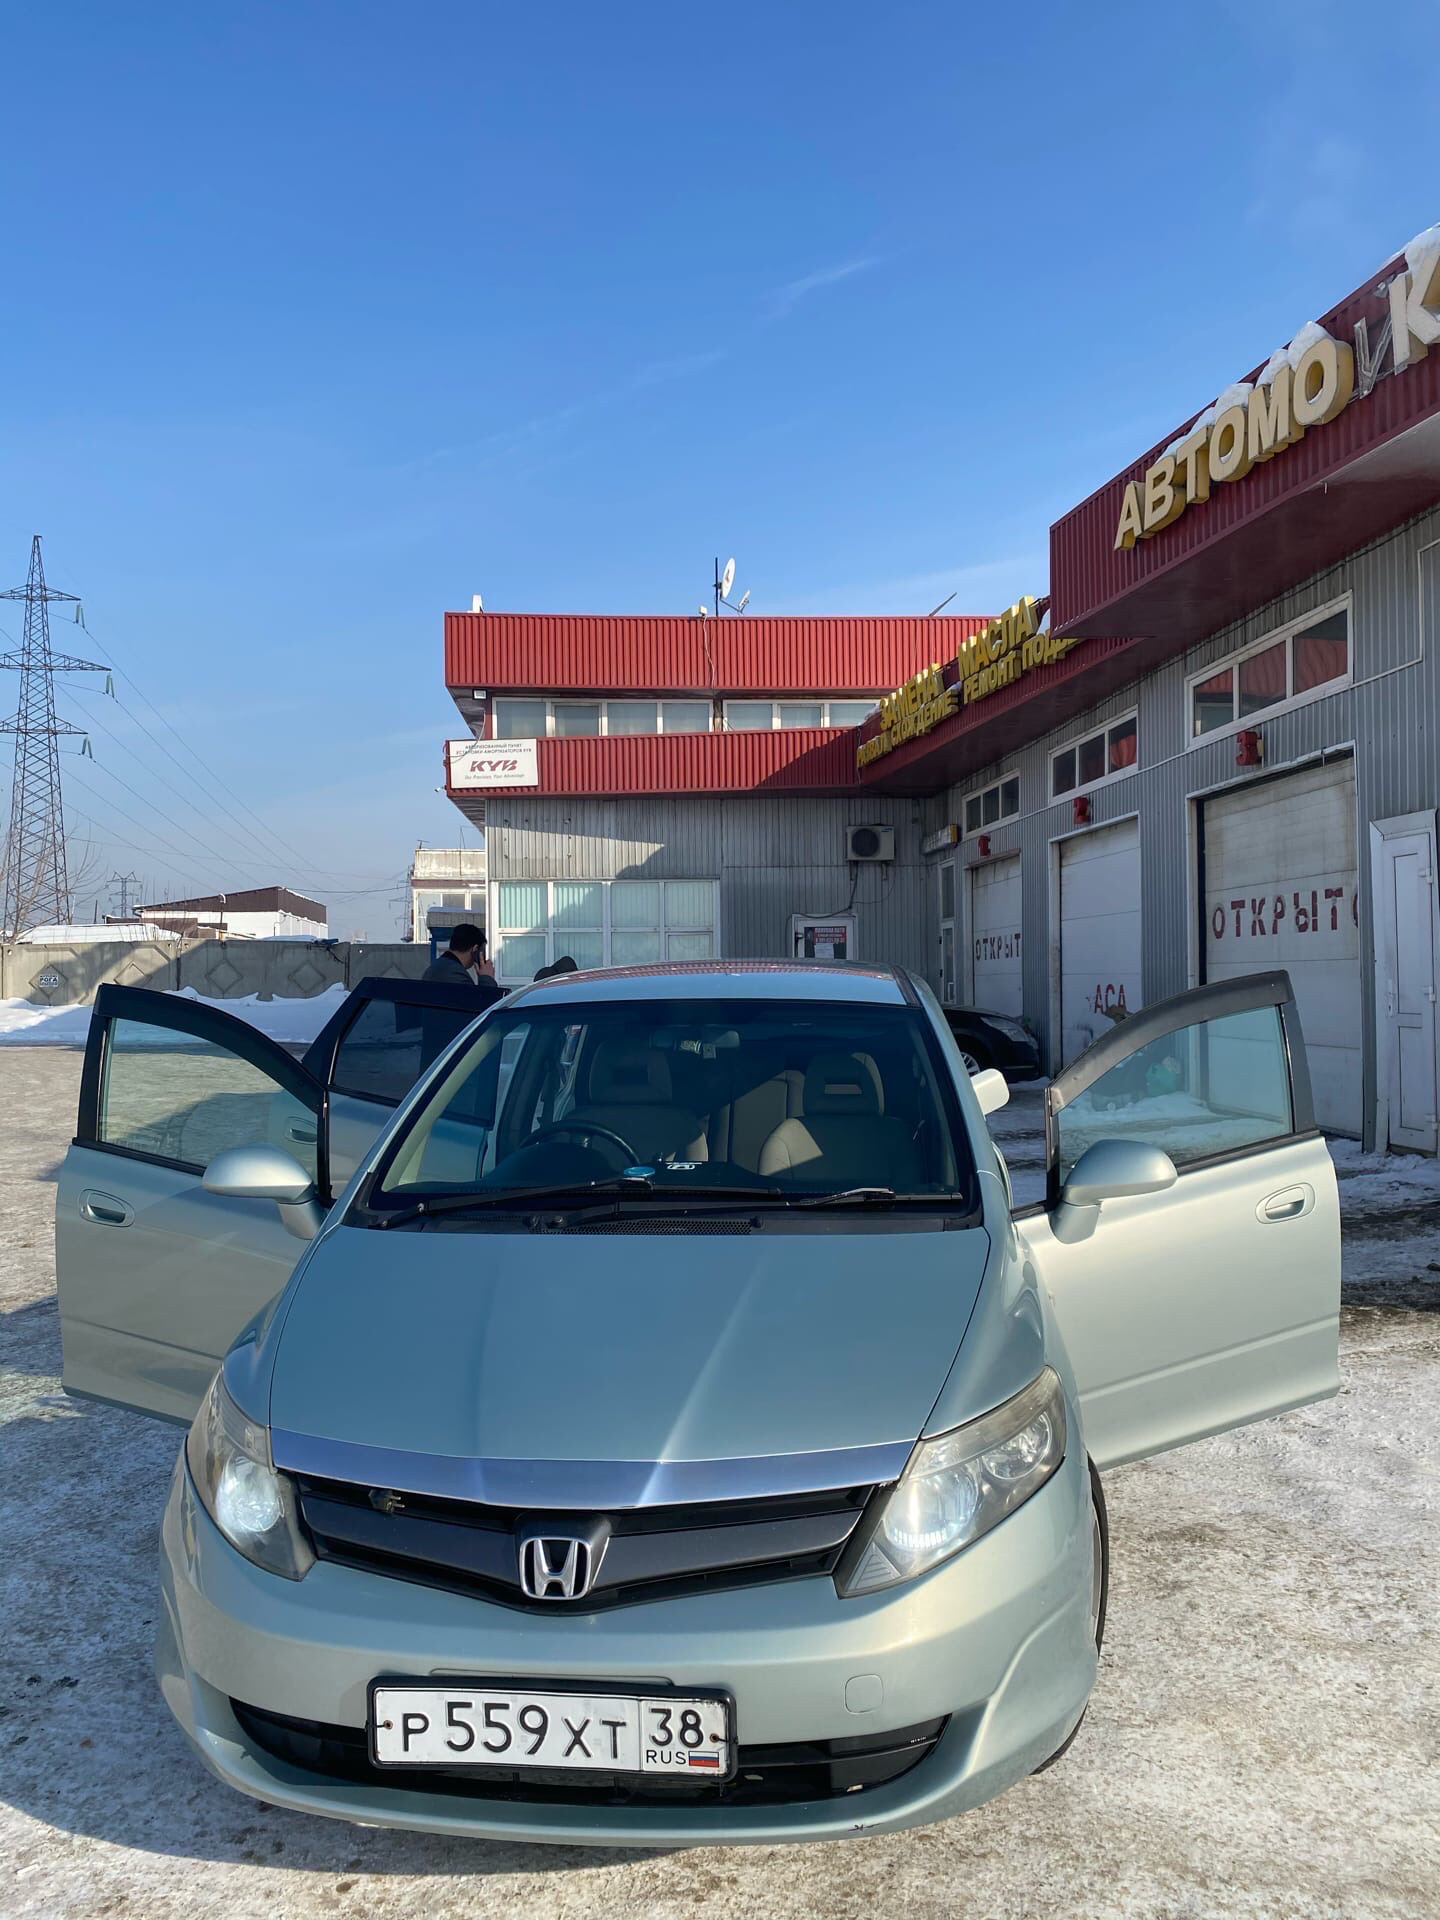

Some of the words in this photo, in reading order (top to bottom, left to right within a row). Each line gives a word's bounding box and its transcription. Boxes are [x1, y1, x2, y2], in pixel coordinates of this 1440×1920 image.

[880, 663, 944, 732] ЗАМЕНА
[958, 596, 1040, 681] МАСЛА
[963, 650, 1021, 704] РЕМОНТ
[470, 760, 518, 772] KYB
[650, 1708, 704, 1748] 38
[646, 1749, 687, 1765] RUS
